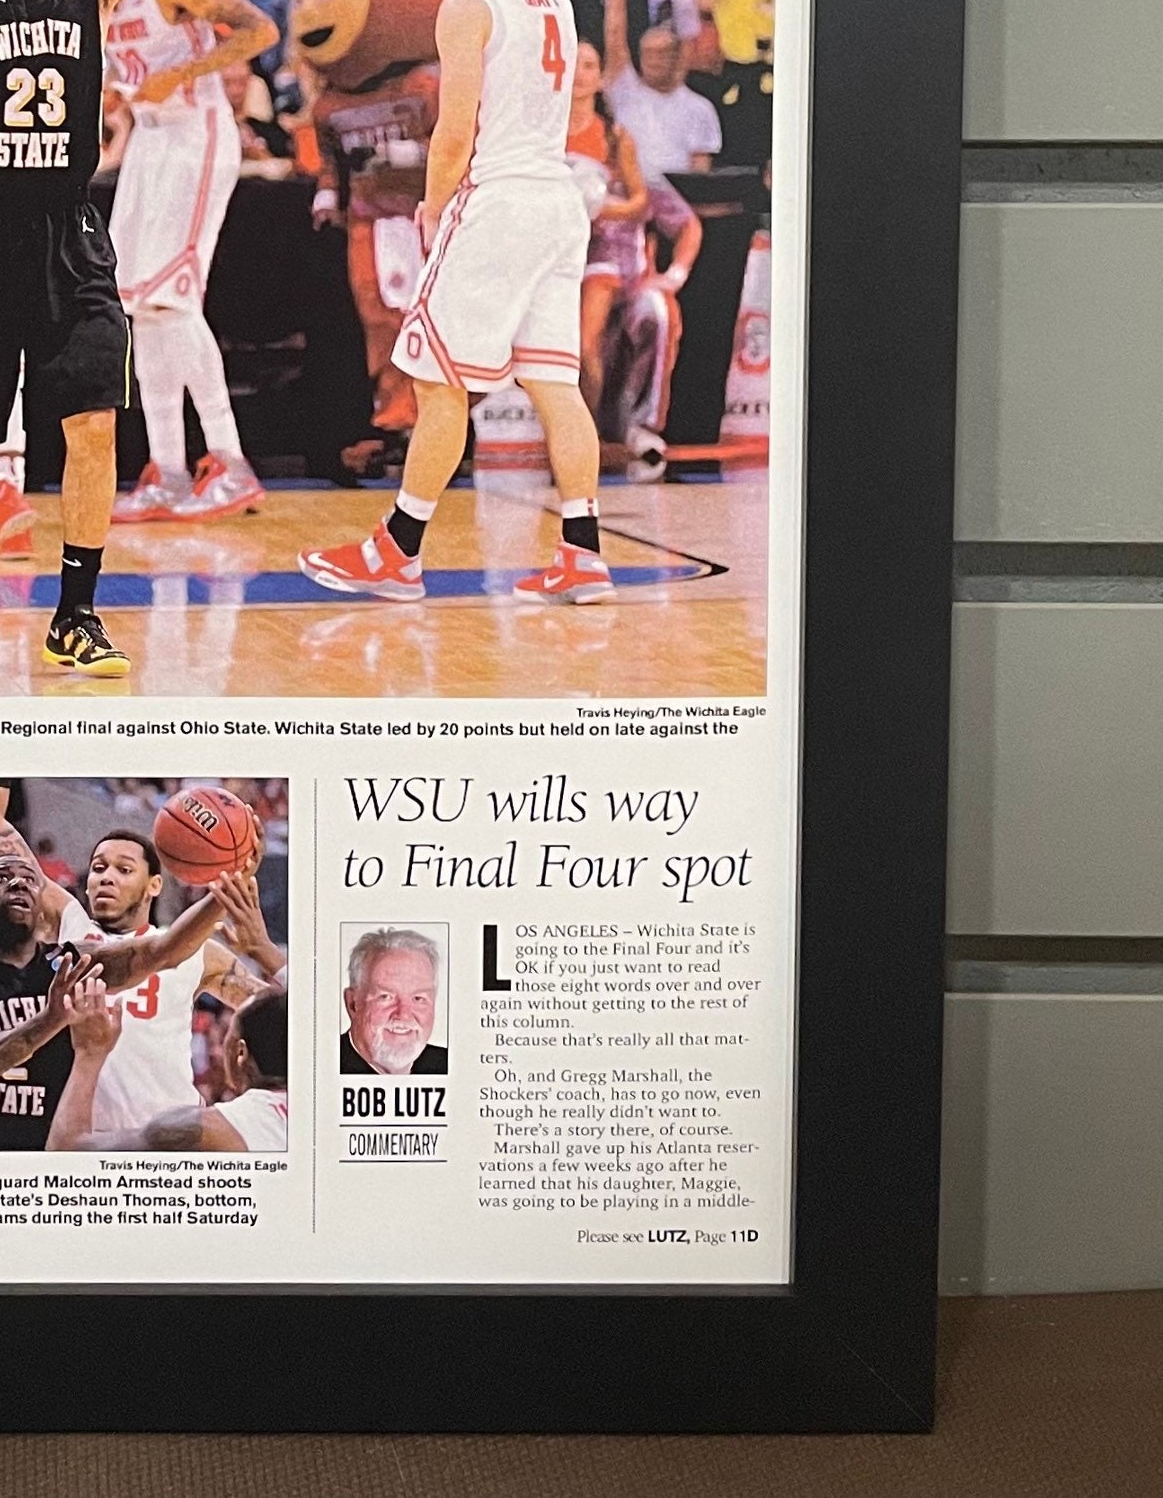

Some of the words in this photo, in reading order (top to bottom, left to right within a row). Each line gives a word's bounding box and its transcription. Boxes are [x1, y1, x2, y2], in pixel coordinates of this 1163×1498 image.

[542, 14, 566, 92] 4
[4, 68, 66, 127] 23
[576, 707, 611, 718] Travis
[613, 706, 683, 720] Heying/The
[685, 706, 730, 717] Wichita
[732, 705, 767, 718] Eagle
[1, 720, 72, 738] Regional
[76, 720, 112, 734] final
[116, 721, 176, 737] against
[180, 720, 219, 735] Ohio
[224, 721, 270, 735] State.
[274, 721, 335, 735] Wichita
[340, 722, 383, 736] State
[387, 722, 411, 736] led
[417, 722, 436, 739] by
[440, 722, 459, 736] 20
[464, 722, 514, 739] points
[519, 722, 545, 736] but
[550, 722, 584, 736] held
[589, 725, 610, 736] on
[615, 722, 645, 736] late
[649, 722, 709, 738] against
[713, 721, 739, 735] the
[343, 776, 475, 822] WSU
[486, 774, 587, 823] wills
[604, 789, 699, 836] way
[344, 849, 384, 888] to
[401, 840, 518, 889] Final
[535, 844, 649, 889] Four
[661, 848, 753, 904] spot
[494, 1069, 522, 1084] Oh,
[527, 1068, 555, 1082] and
[561, 1069, 607, 1086] Gregg
[612, 1068, 683, 1084] Marshall,
[688, 1068, 712, 1082] the
[342, 1086, 386, 1118] BOB
[394, 1087, 446, 1118] LUTZ
[349, 1132, 439, 1156] COMMENTARY
[98, 1159, 134, 1171] Travis
[136, 1159, 204, 1173] Heying/The
[206, 1160, 251, 1171] Wichita
[254, 1160, 288, 1173] Eagle
[44, 1175, 112, 1189] Malcolm
[116, 1175, 193, 1189] Armstead
[197, 1176, 252, 1189] shoots
[577, 1229, 619, 1243] Please
[623, 1233, 644, 1243] see
[648, 1230, 691, 1245] LUTZ,
[695, 1230, 726, 1246] Page
[731, 1229, 759, 1243] 11D
